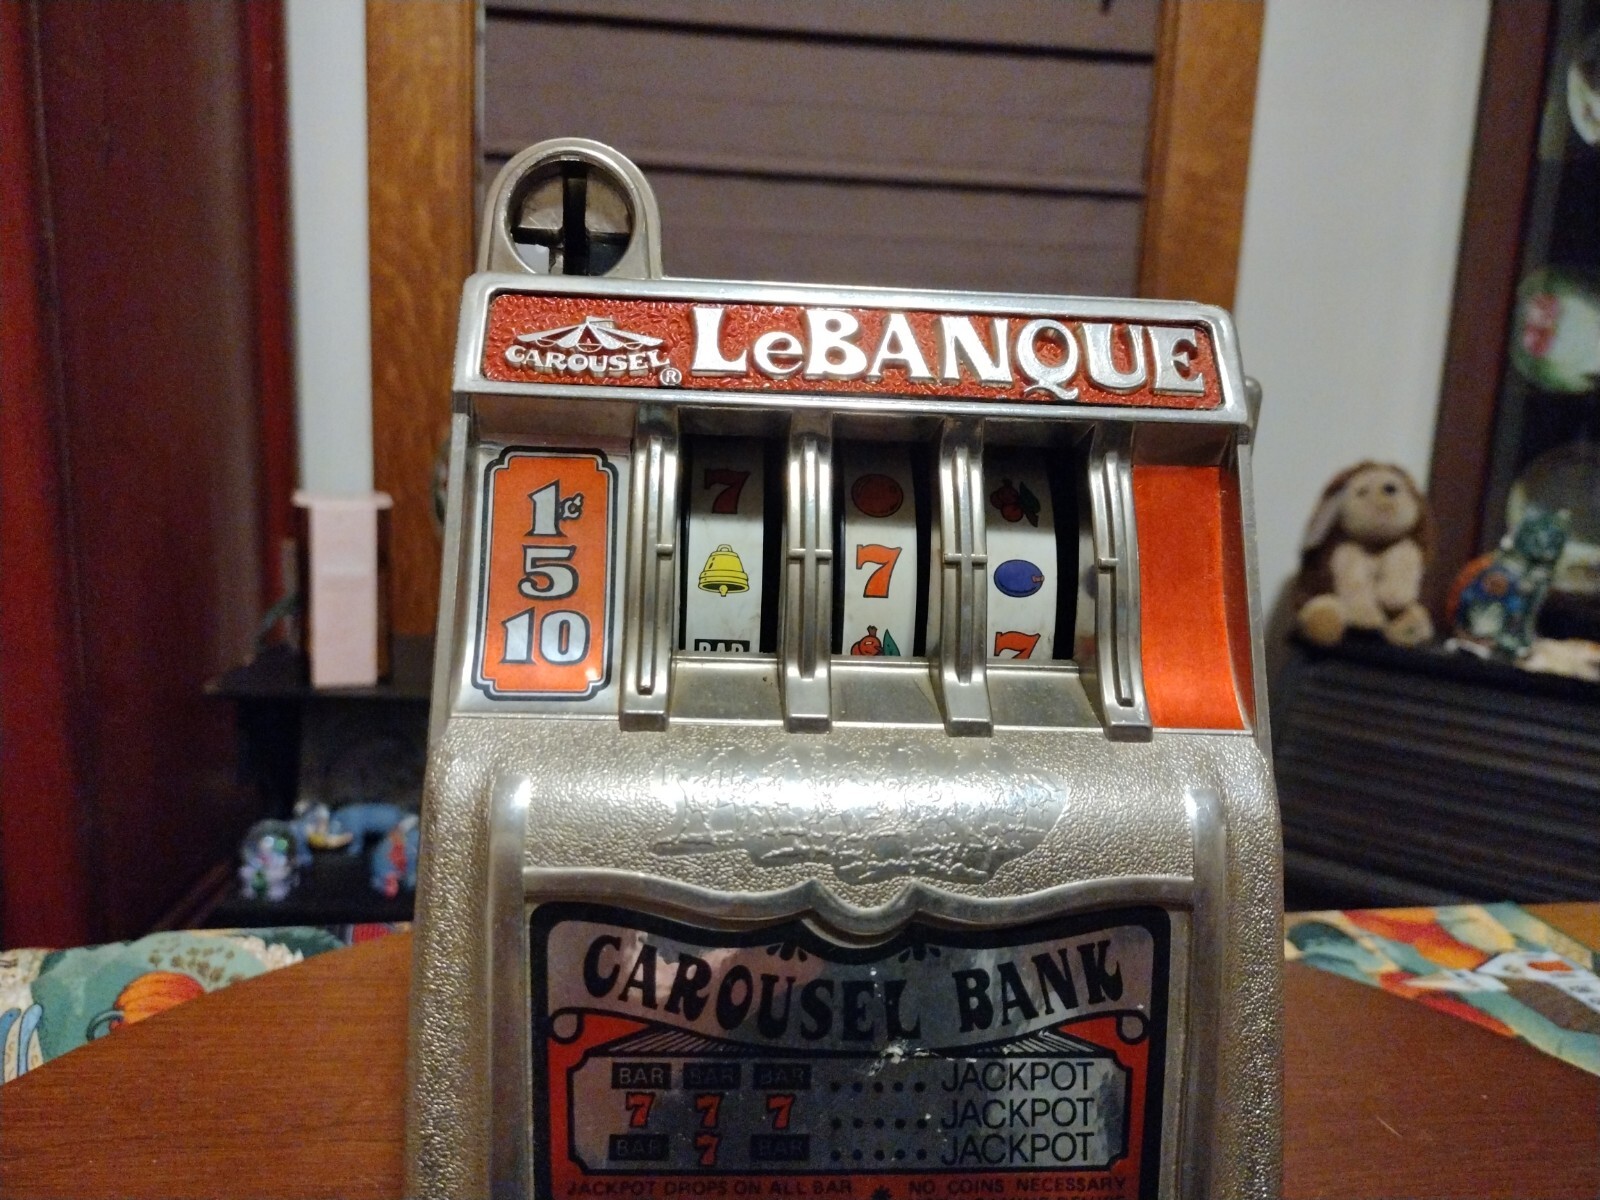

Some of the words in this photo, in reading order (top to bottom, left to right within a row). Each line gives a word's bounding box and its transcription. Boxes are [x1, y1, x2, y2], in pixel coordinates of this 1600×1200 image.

[505, 346, 671, 375] CAROUSEL
[692, 307, 1204, 400] LeBANQUE
[704, 468, 751, 514] 7
[517, 544, 579, 600] 5
[856, 543, 902, 598] 7
[500, 607, 590, 665] 10
[583, 934, 921, 1040] CAROUSEL
[952, 940, 1124, 1033] BANK
[619, 1067, 664, 1085] BAR
[691, 1068, 734, 1085] BAR
[760, 1068, 804, 1085] BAR
[941, 1061, 1094, 1091] JACKPOT
[626, 1092, 655, 1128] 7
[695, 1093, 724, 1128] 7
[766, 1093, 795, 1129] 7
[941, 1097, 1095, 1129] JACKPOT
[694, 1132, 722, 1165] 7
[941, 1132, 1095, 1164] JACKPOT
[567, 1180, 655, 1196] JACKPOT
[663, 1180, 727, 1195] DROPS
[734, 1180, 761, 1195] ON
[768, 1180, 807, 1195] ALL
[813, 1180, 853, 1194] BAR
[908, 1180, 936, 1195] NO
[947, 1179, 1004, 1194] COINS
[1016, 1177, 1127, 1192] NECESSARY
